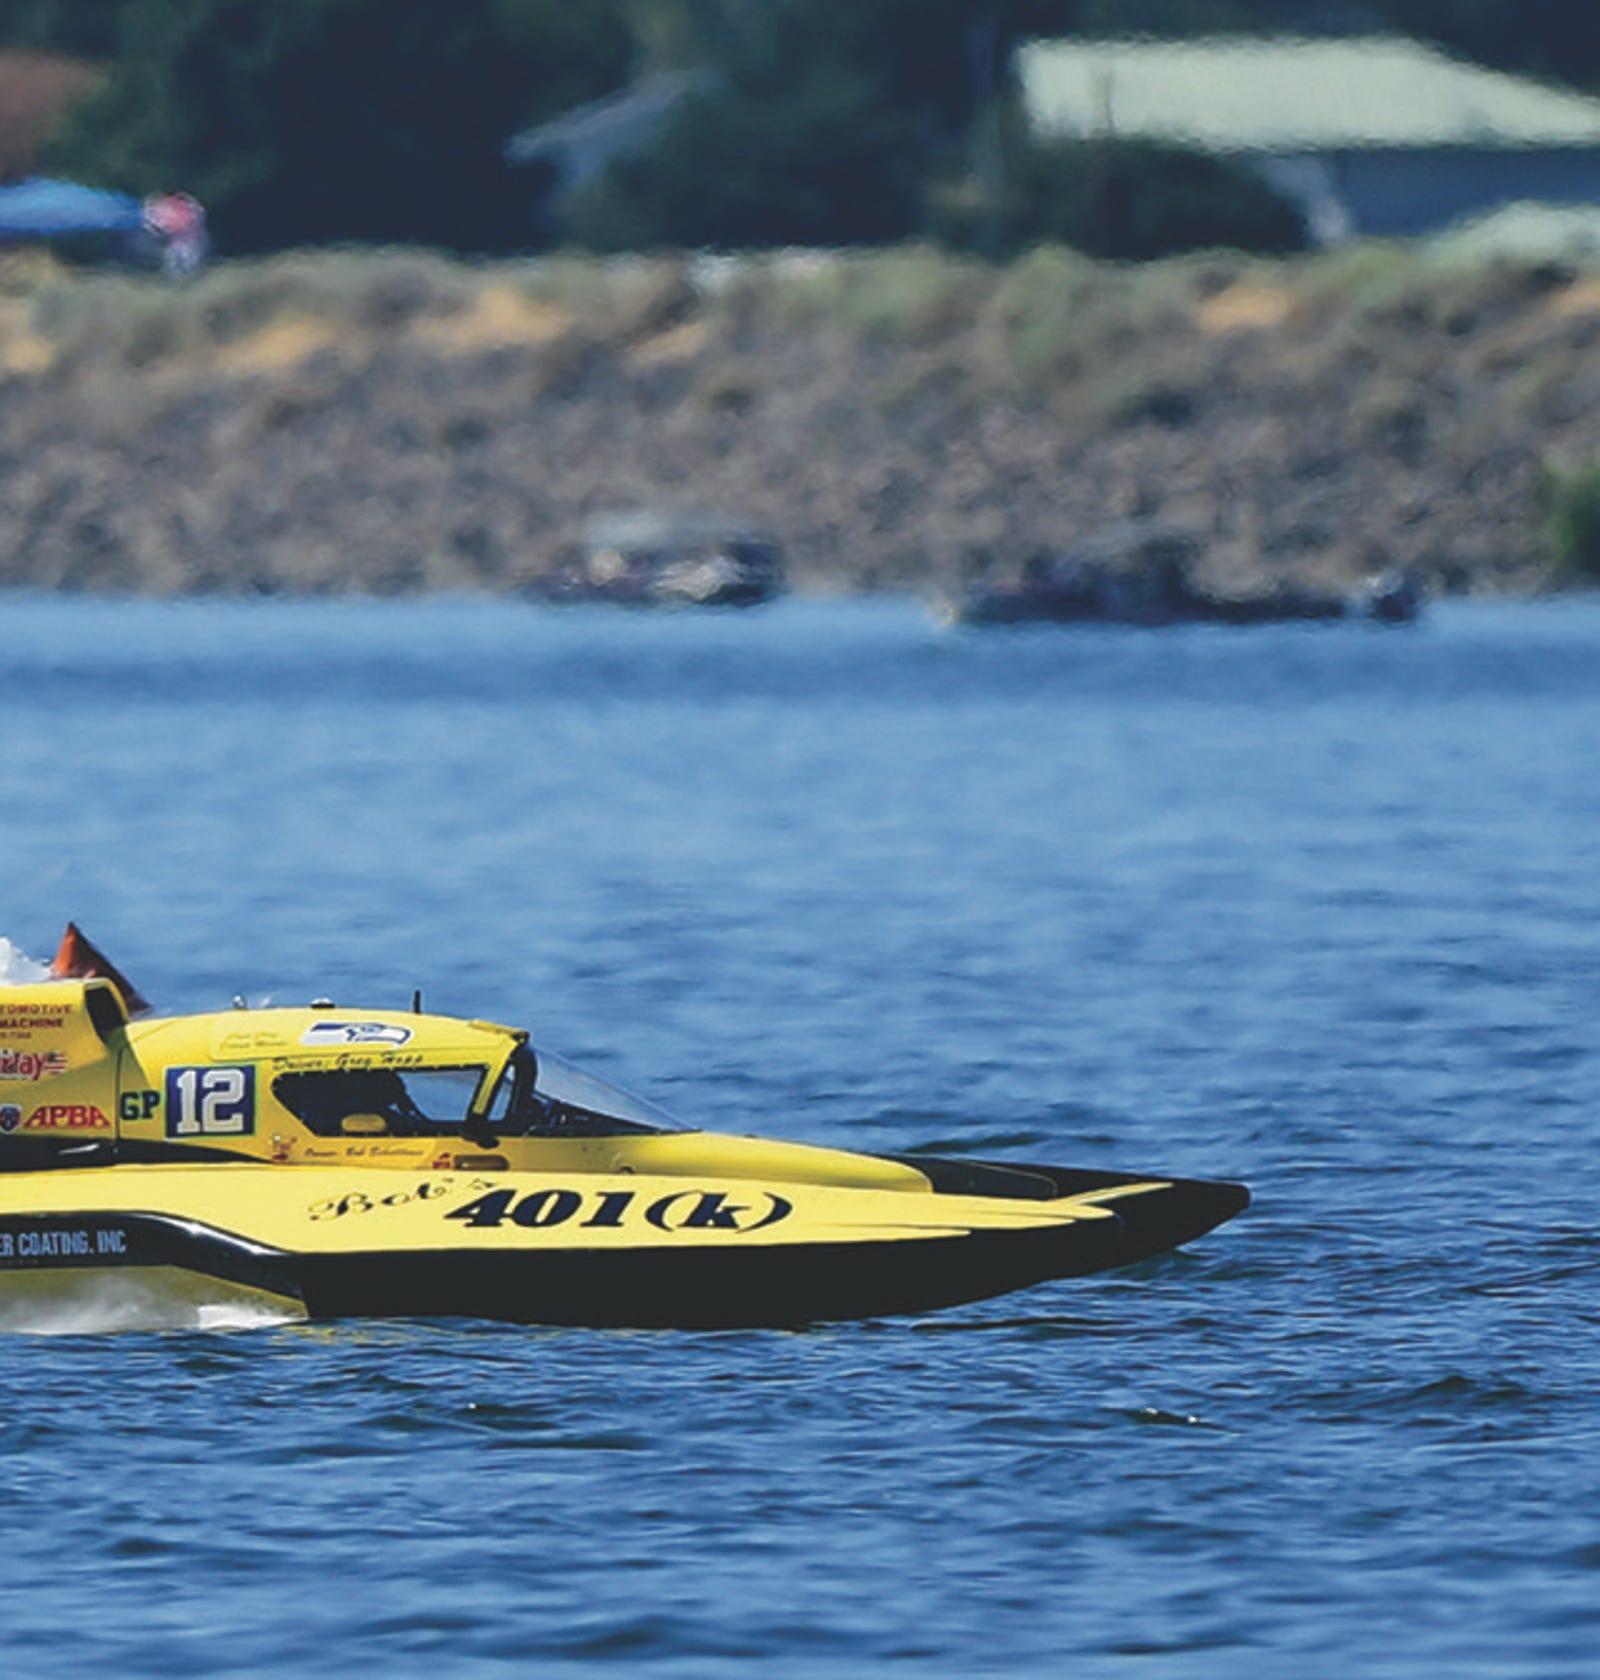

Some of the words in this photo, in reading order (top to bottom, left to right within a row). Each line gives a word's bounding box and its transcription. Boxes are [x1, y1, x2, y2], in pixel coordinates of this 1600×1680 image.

[335, 1052, 373, 1070] Greg
[119, 1090, 160, 1120] GP
[177, 1069, 244, 1133] 12
[25, 1105, 112, 1129] APBA
[308, 1177, 500, 1220] Bob's
[443, 1189, 793, 1234] 401(k)
